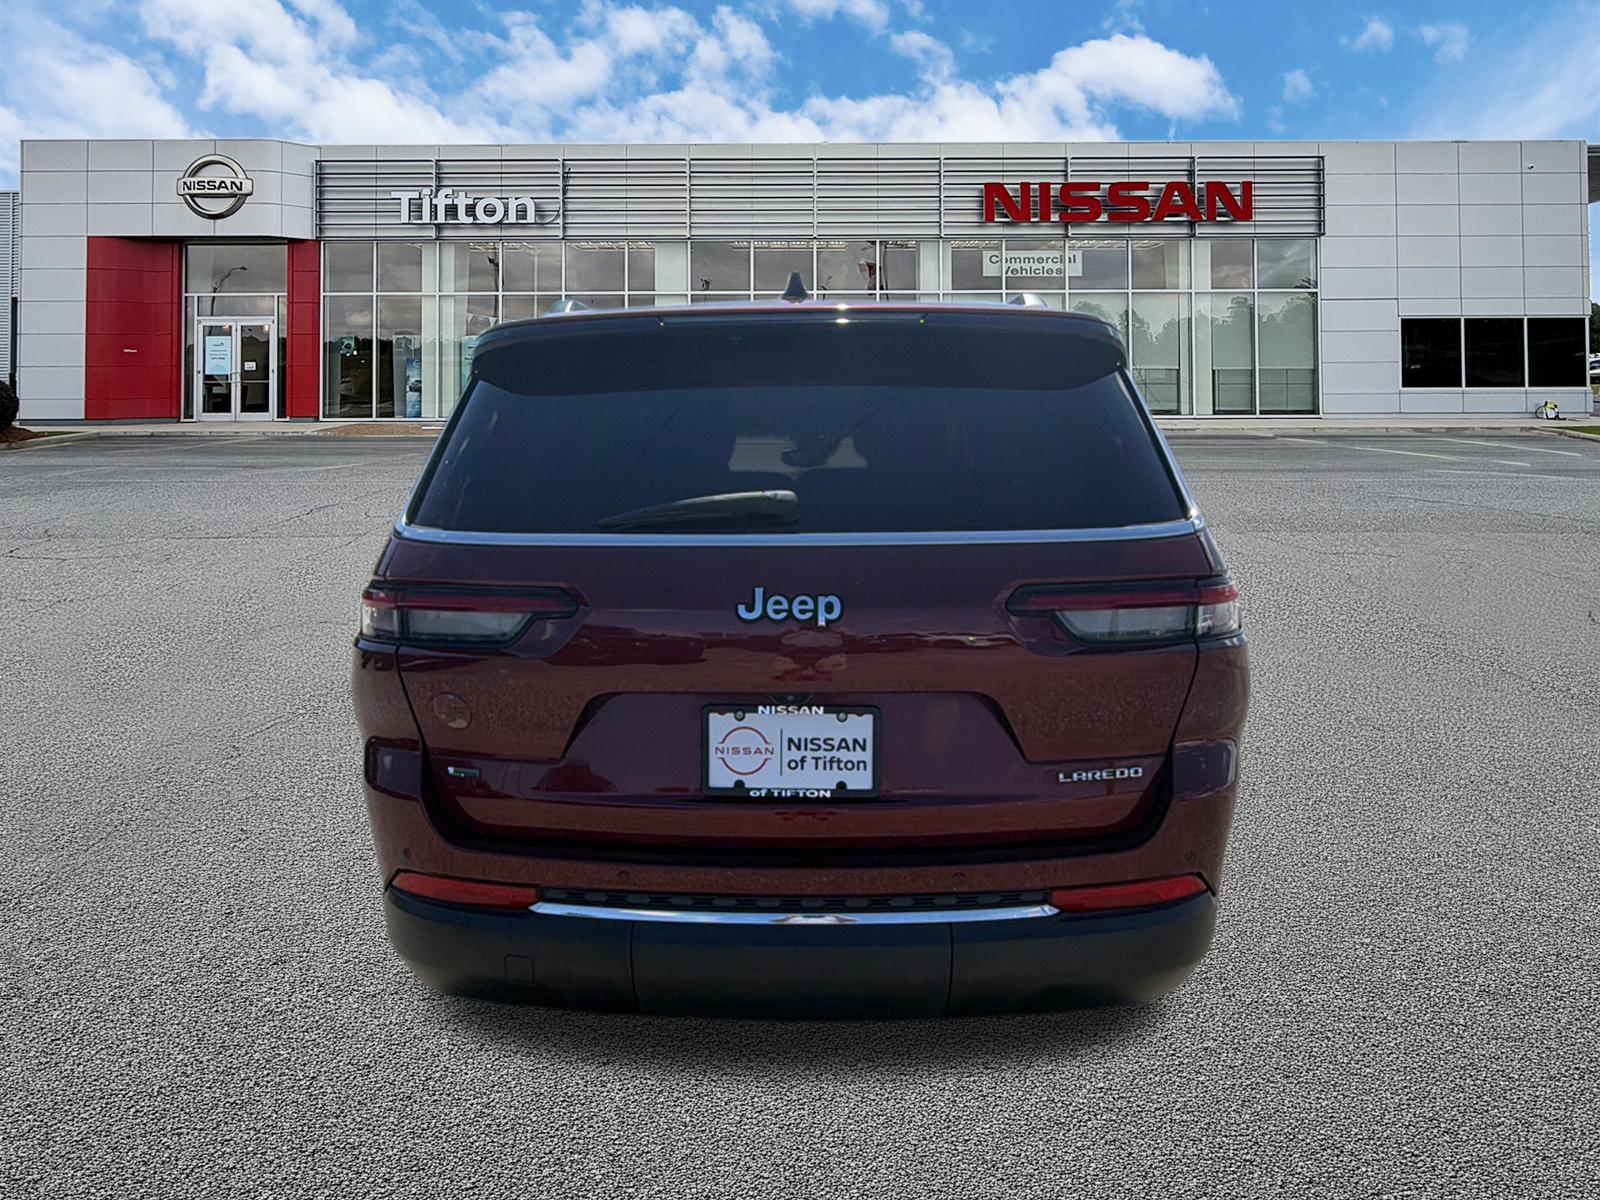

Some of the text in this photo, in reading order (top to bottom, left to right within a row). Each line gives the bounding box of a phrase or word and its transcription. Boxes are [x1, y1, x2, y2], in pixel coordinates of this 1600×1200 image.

[182, 180, 243, 191] NISSAN
[391, 188, 536, 224] Tifton
[983, 181, 1253, 222] NISSAN
[737, 587, 842, 627] Jeep
[757, 705, 824, 715] NISSAN
[715, 746, 774, 756] NISSAN
[787, 737, 867, 752] NISSAN
[787, 756, 867, 771] of Tifton
[1058, 767, 1143, 782] LAREDO
[749, 788, 831, 798] of TIFTON
